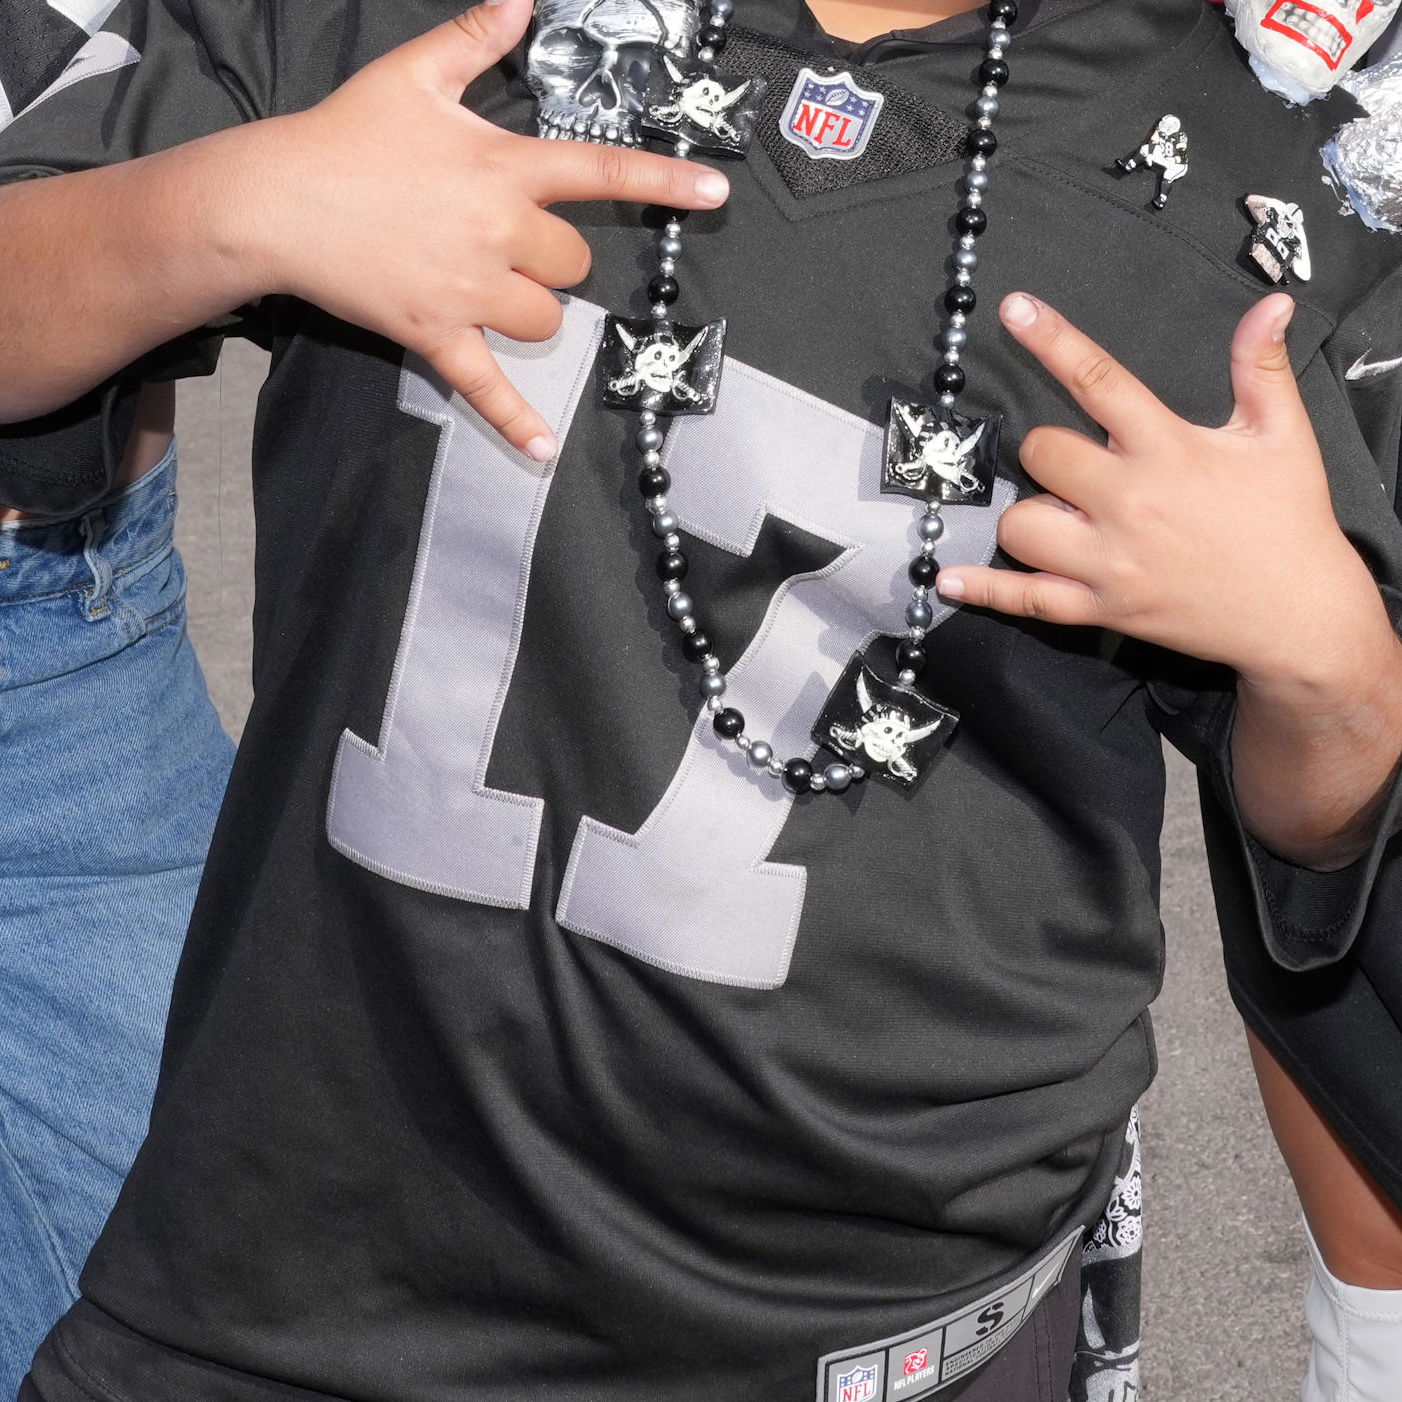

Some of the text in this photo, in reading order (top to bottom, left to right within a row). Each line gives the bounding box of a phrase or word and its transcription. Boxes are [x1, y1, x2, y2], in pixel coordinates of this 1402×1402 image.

[792, 103, 853, 148] NFL
[325, 289, 1018, 991] 17
[975, 1301, 1005, 1336] S
[842, 1382, 871, 1402] NFL
[893, 1364, 935, 1391] NFL PLAYERS
